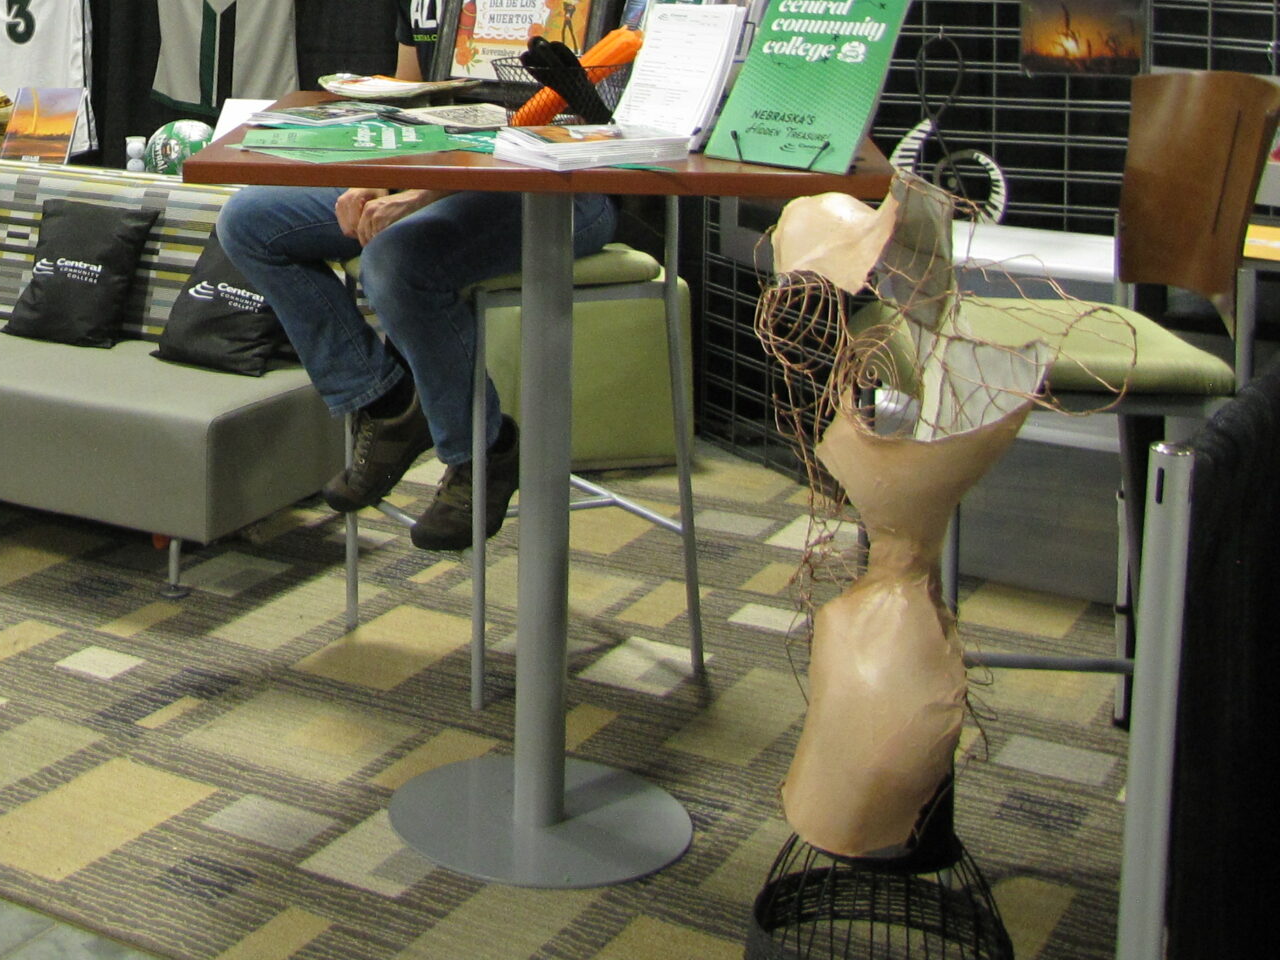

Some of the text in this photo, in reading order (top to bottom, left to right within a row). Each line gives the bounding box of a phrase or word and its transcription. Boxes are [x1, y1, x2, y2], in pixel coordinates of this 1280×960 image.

[487, 13, 534, 25] MUERTOS
[771, 16, 887, 42] community
[480, 47, 515, 56] November
[762, 36, 836, 62] college
[751, 109, 816, 126] NEBRASKA'S
[56, 257, 103, 273] Central
[59, 266, 100, 279] COMMUNITY
[66, 272, 98, 284] COLLEGE
[217, 282, 265, 302] Central
